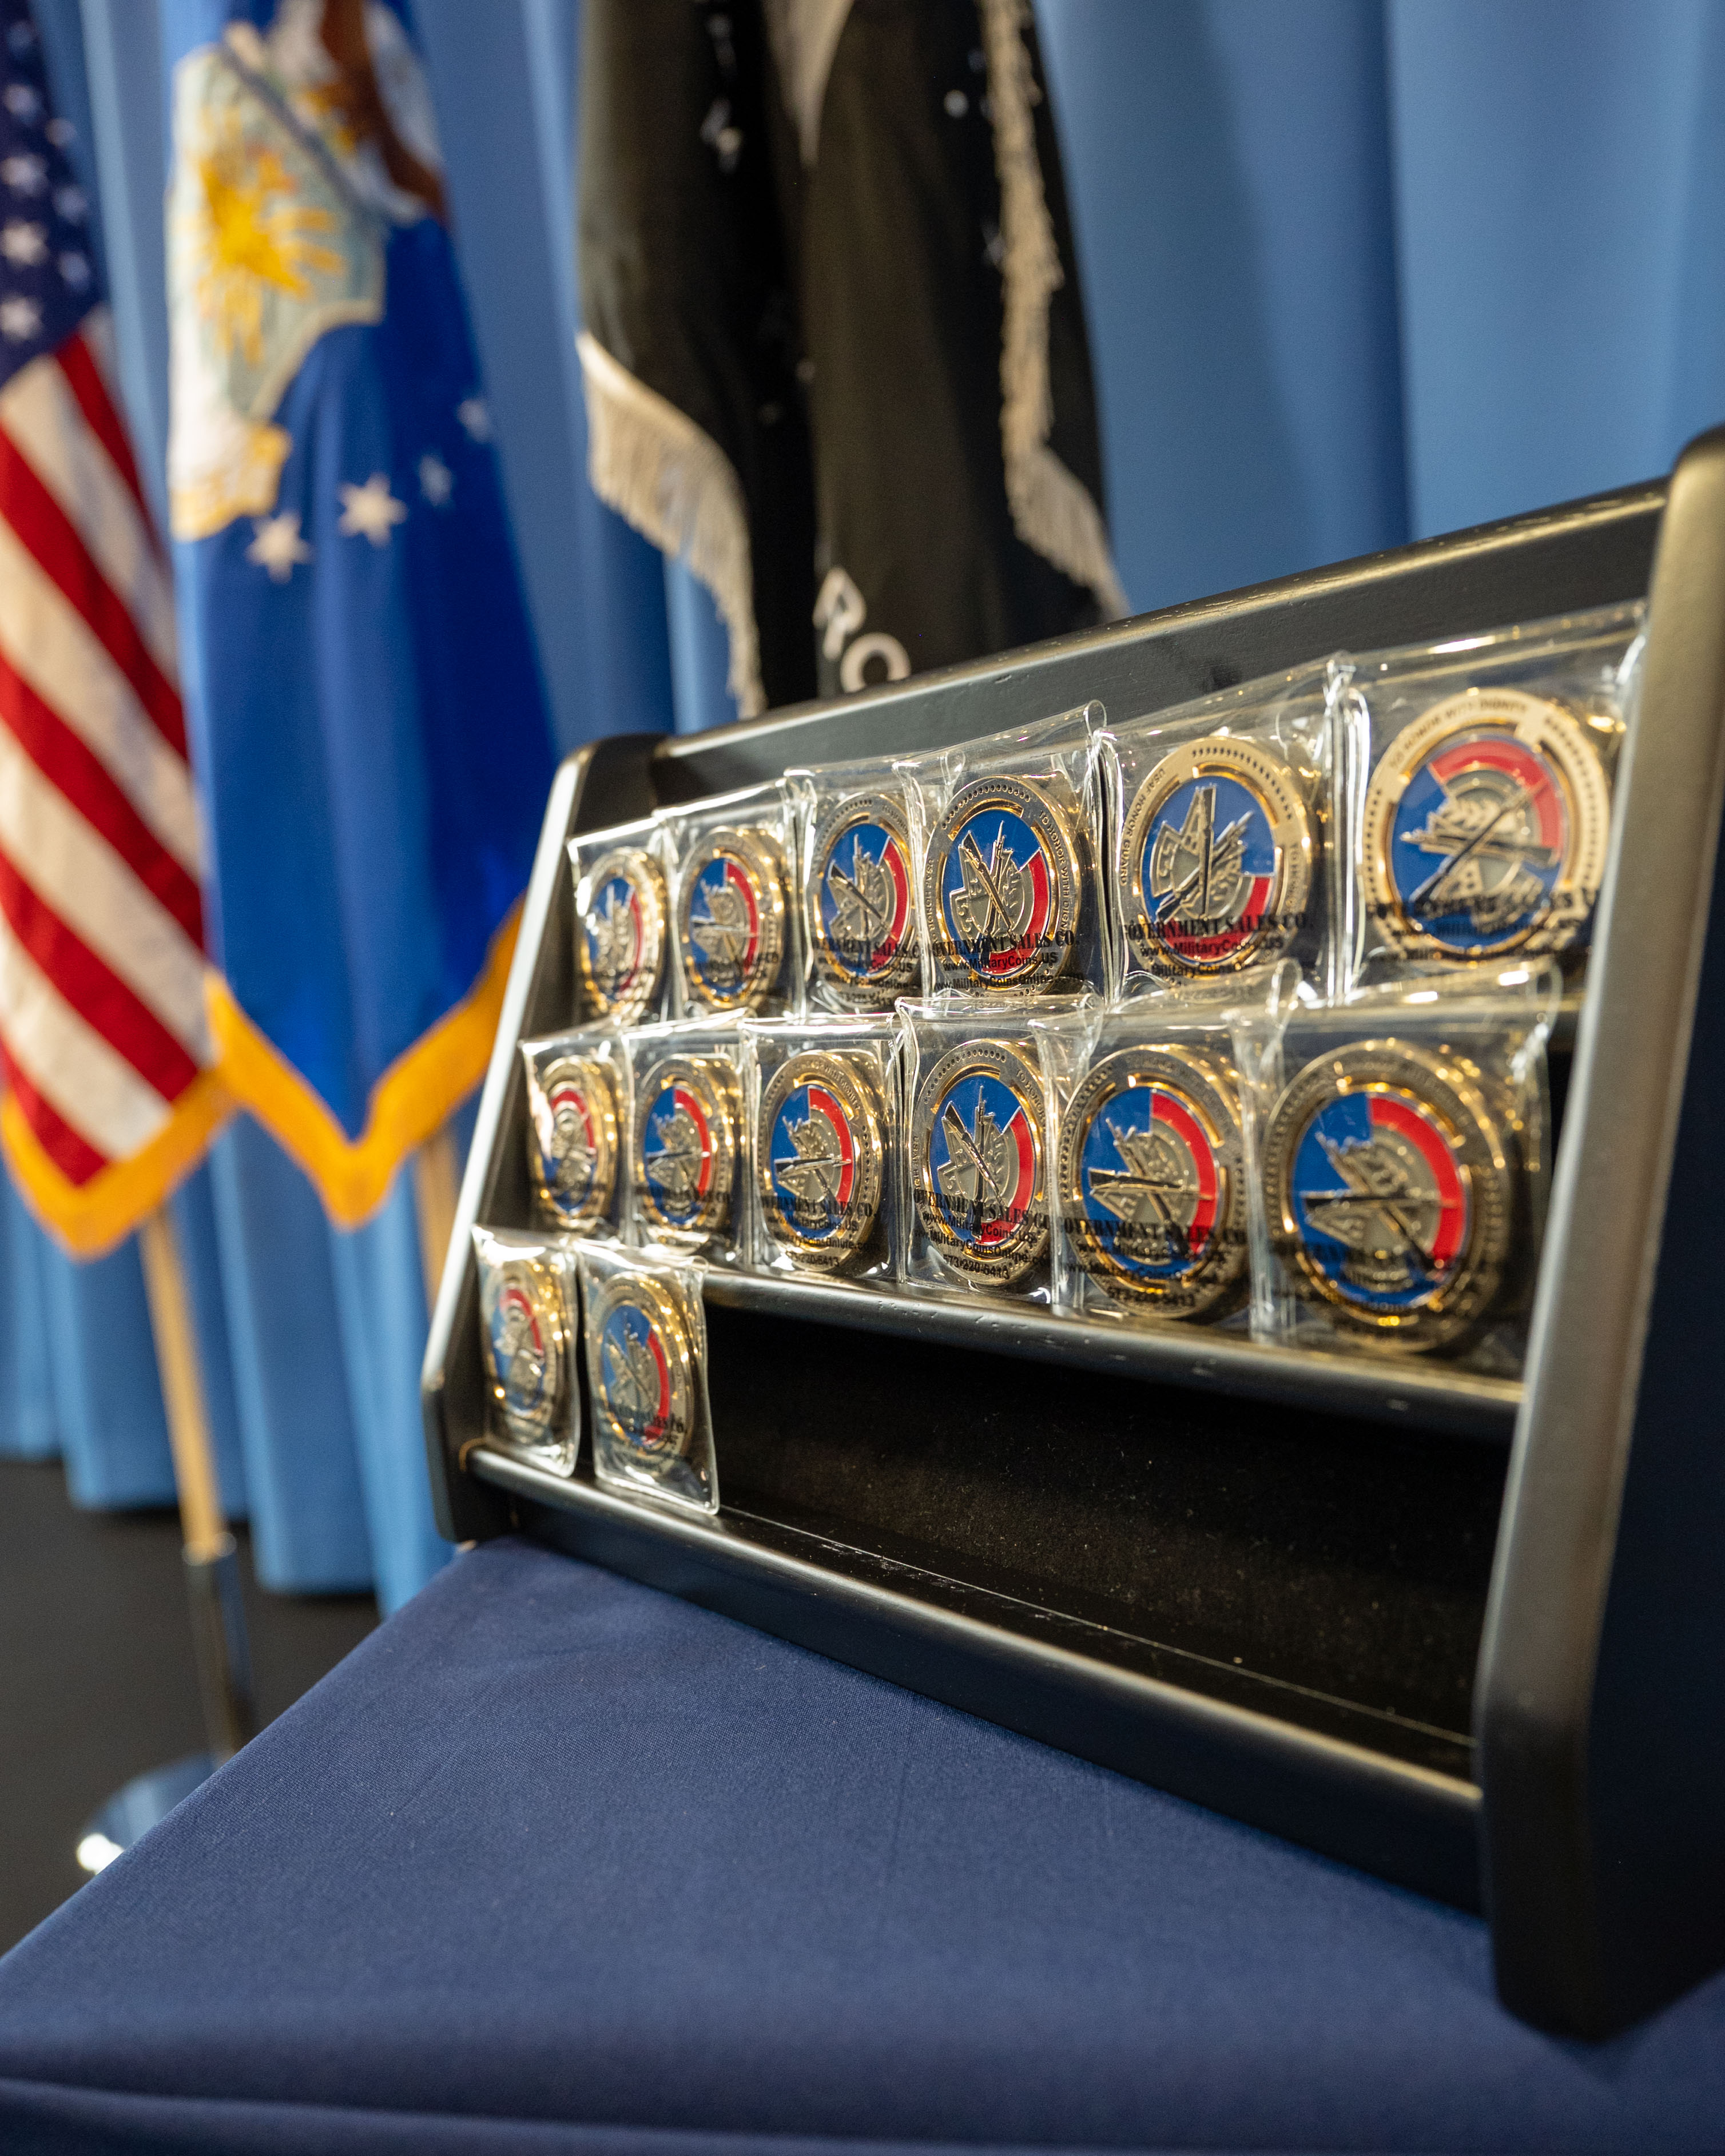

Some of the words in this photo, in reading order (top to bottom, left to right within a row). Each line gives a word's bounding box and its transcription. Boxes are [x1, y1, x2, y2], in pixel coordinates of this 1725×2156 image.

[1126, 794, 1146, 837] HONOR
[1039, 810, 1050, 825] TO
[1047, 824, 1066, 865] HONOR
[1061, 866, 1070, 896] WITH
[1120, 840, 1131, 886] GUARD
[925, 891, 935, 932] HONOR
[1009, 932, 1053, 950] SALES
[944, 951, 1058, 971] www.MitaryCoins.US
[935, 972, 1085, 991] ww.MilitaryCoinsOnline.com
[923, 1212, 1038, 1243] www.MilitayCoins.US
[988, 1204, 1030, 1226] SALES
